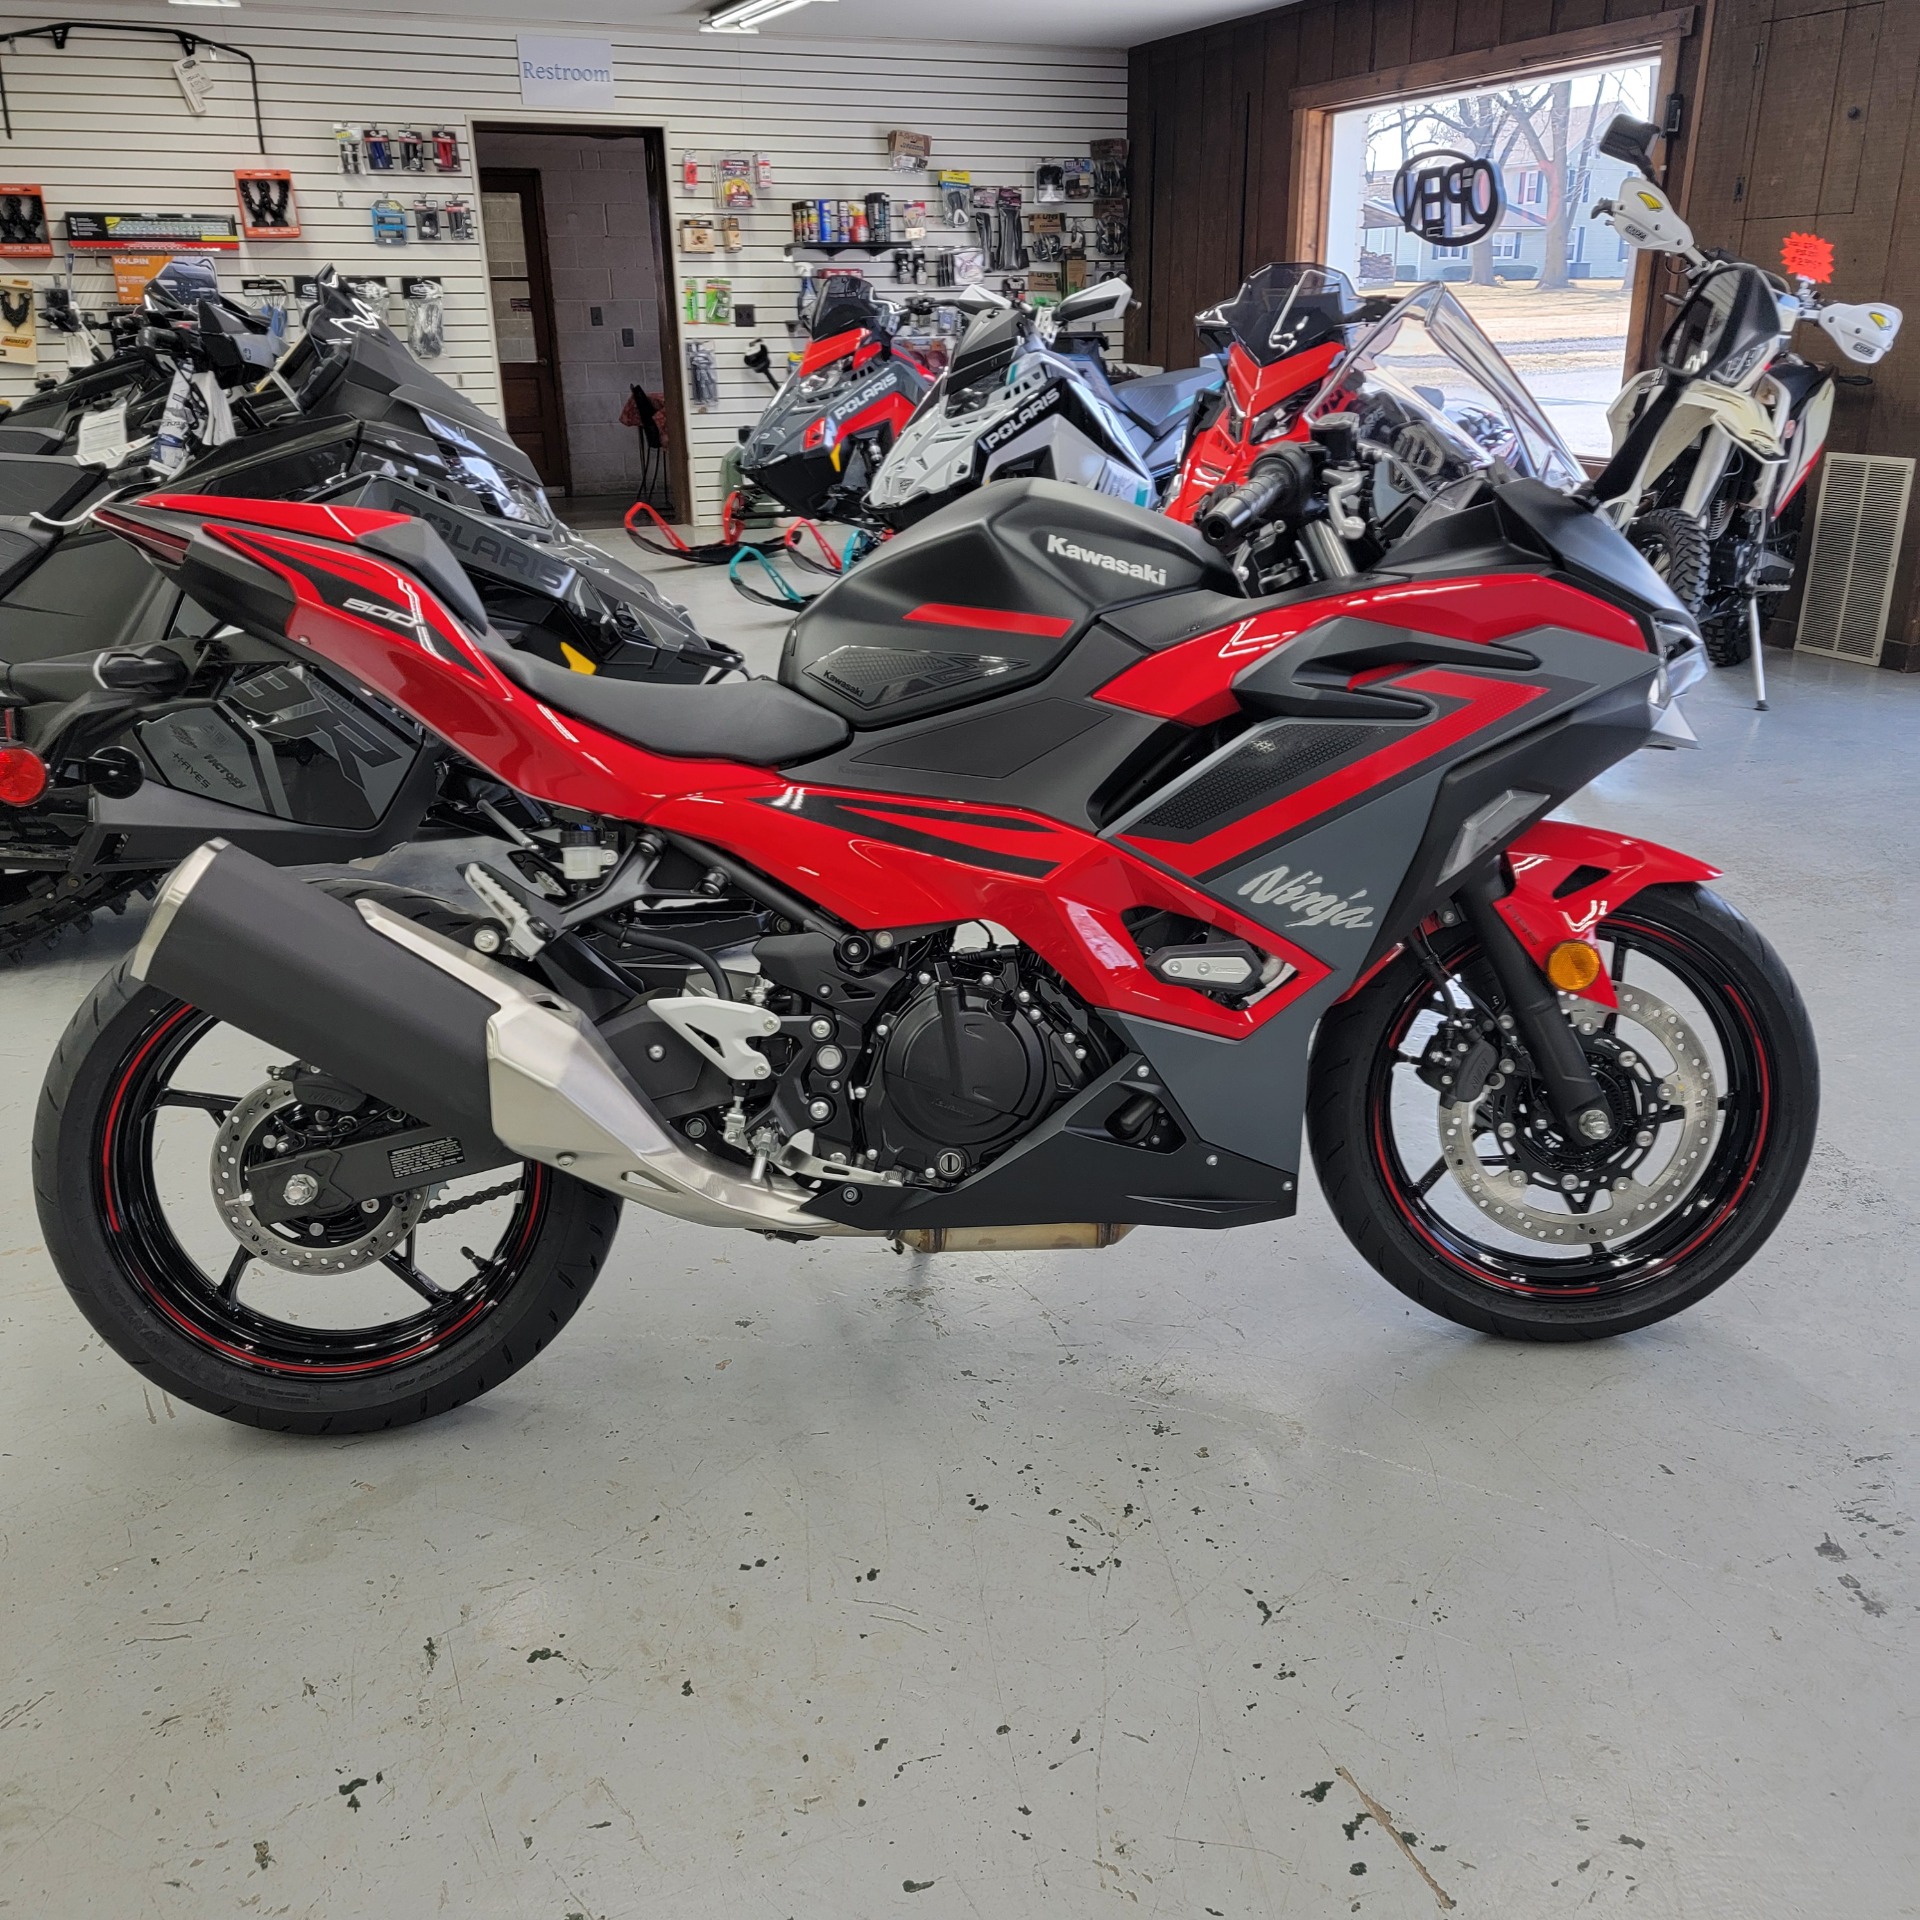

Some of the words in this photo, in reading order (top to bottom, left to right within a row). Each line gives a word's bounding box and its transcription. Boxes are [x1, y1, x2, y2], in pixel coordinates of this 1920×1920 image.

[522, 61, 612, 82] Restroom
[114, 257, 149, 266] KOLPIN
[834, 373, 897, 420] POLARIS
[986, 388, 1060, 450] POLARIS
[1047, 534, 1167, 586] Kawasaki
[823, 669, 865, 698] Kawasaki
[172, 751, 211, 789] HAYES
[203, 753, 248, 789] FACTORY
[1237, 865, 1375, 929] Ninja
